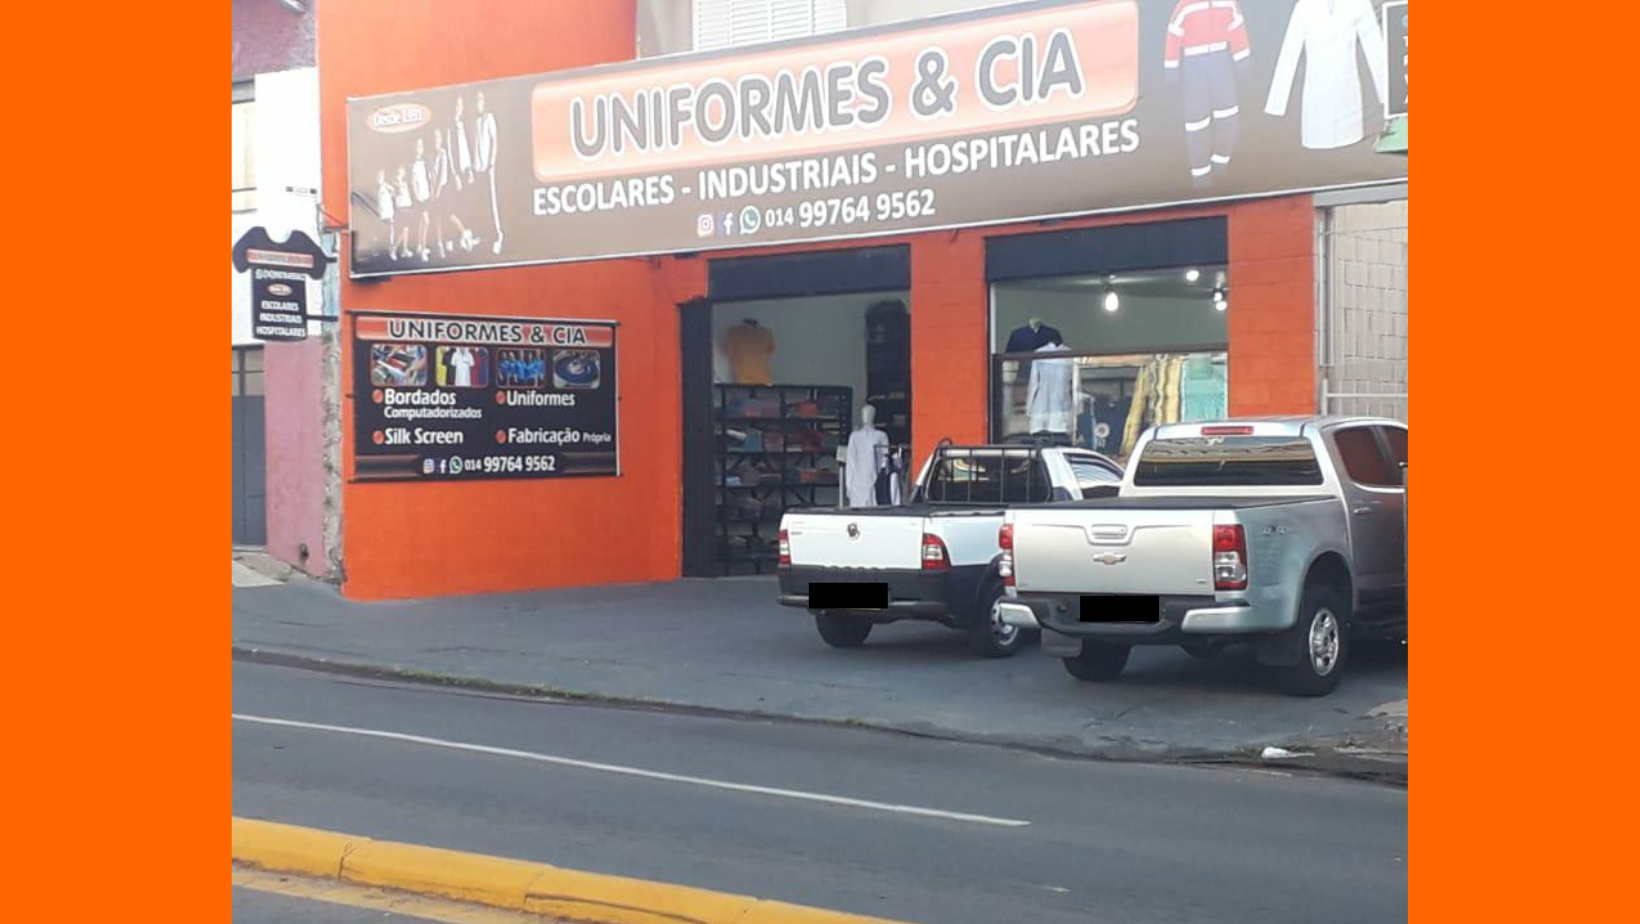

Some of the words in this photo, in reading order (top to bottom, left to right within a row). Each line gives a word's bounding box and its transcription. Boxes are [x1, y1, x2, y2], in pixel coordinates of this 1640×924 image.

[570, 57, 890, 159] UNIFORMES
[911, 50, 957, 118] &
[977, 29, 1084, 108] CIA
[533, 174, 675, 216] ESCOLARES
[699, 152, 877, 200] INDUSTRIAIS
[904, 118, 1140, 179] HOSPITALARES
[765, 208, 795, 228] 014
[799, 198, 870, 228] 99764
[876, 188, 936, 220] 9562
[389, 319, 522, 343] UNIFORMES
[530, 326, 544, 343] &
[553, 326, 586, 345] CIA
[384, 389, 457, 405] Bordados
[506, 390, 575, 406] Uniformes
[384, 406, 482, 420] Computadorizados
[384, 428, 411, 444] Silk
[414, 428, 464, 444] Screen
[508, 427, 580, 445] Fabricação
[582, 432, 612, 443] Própria
[464, 459, 481, 471] 014
[483, 456, 522, 472] 99764
[525, 455, 556, 471] 9562
